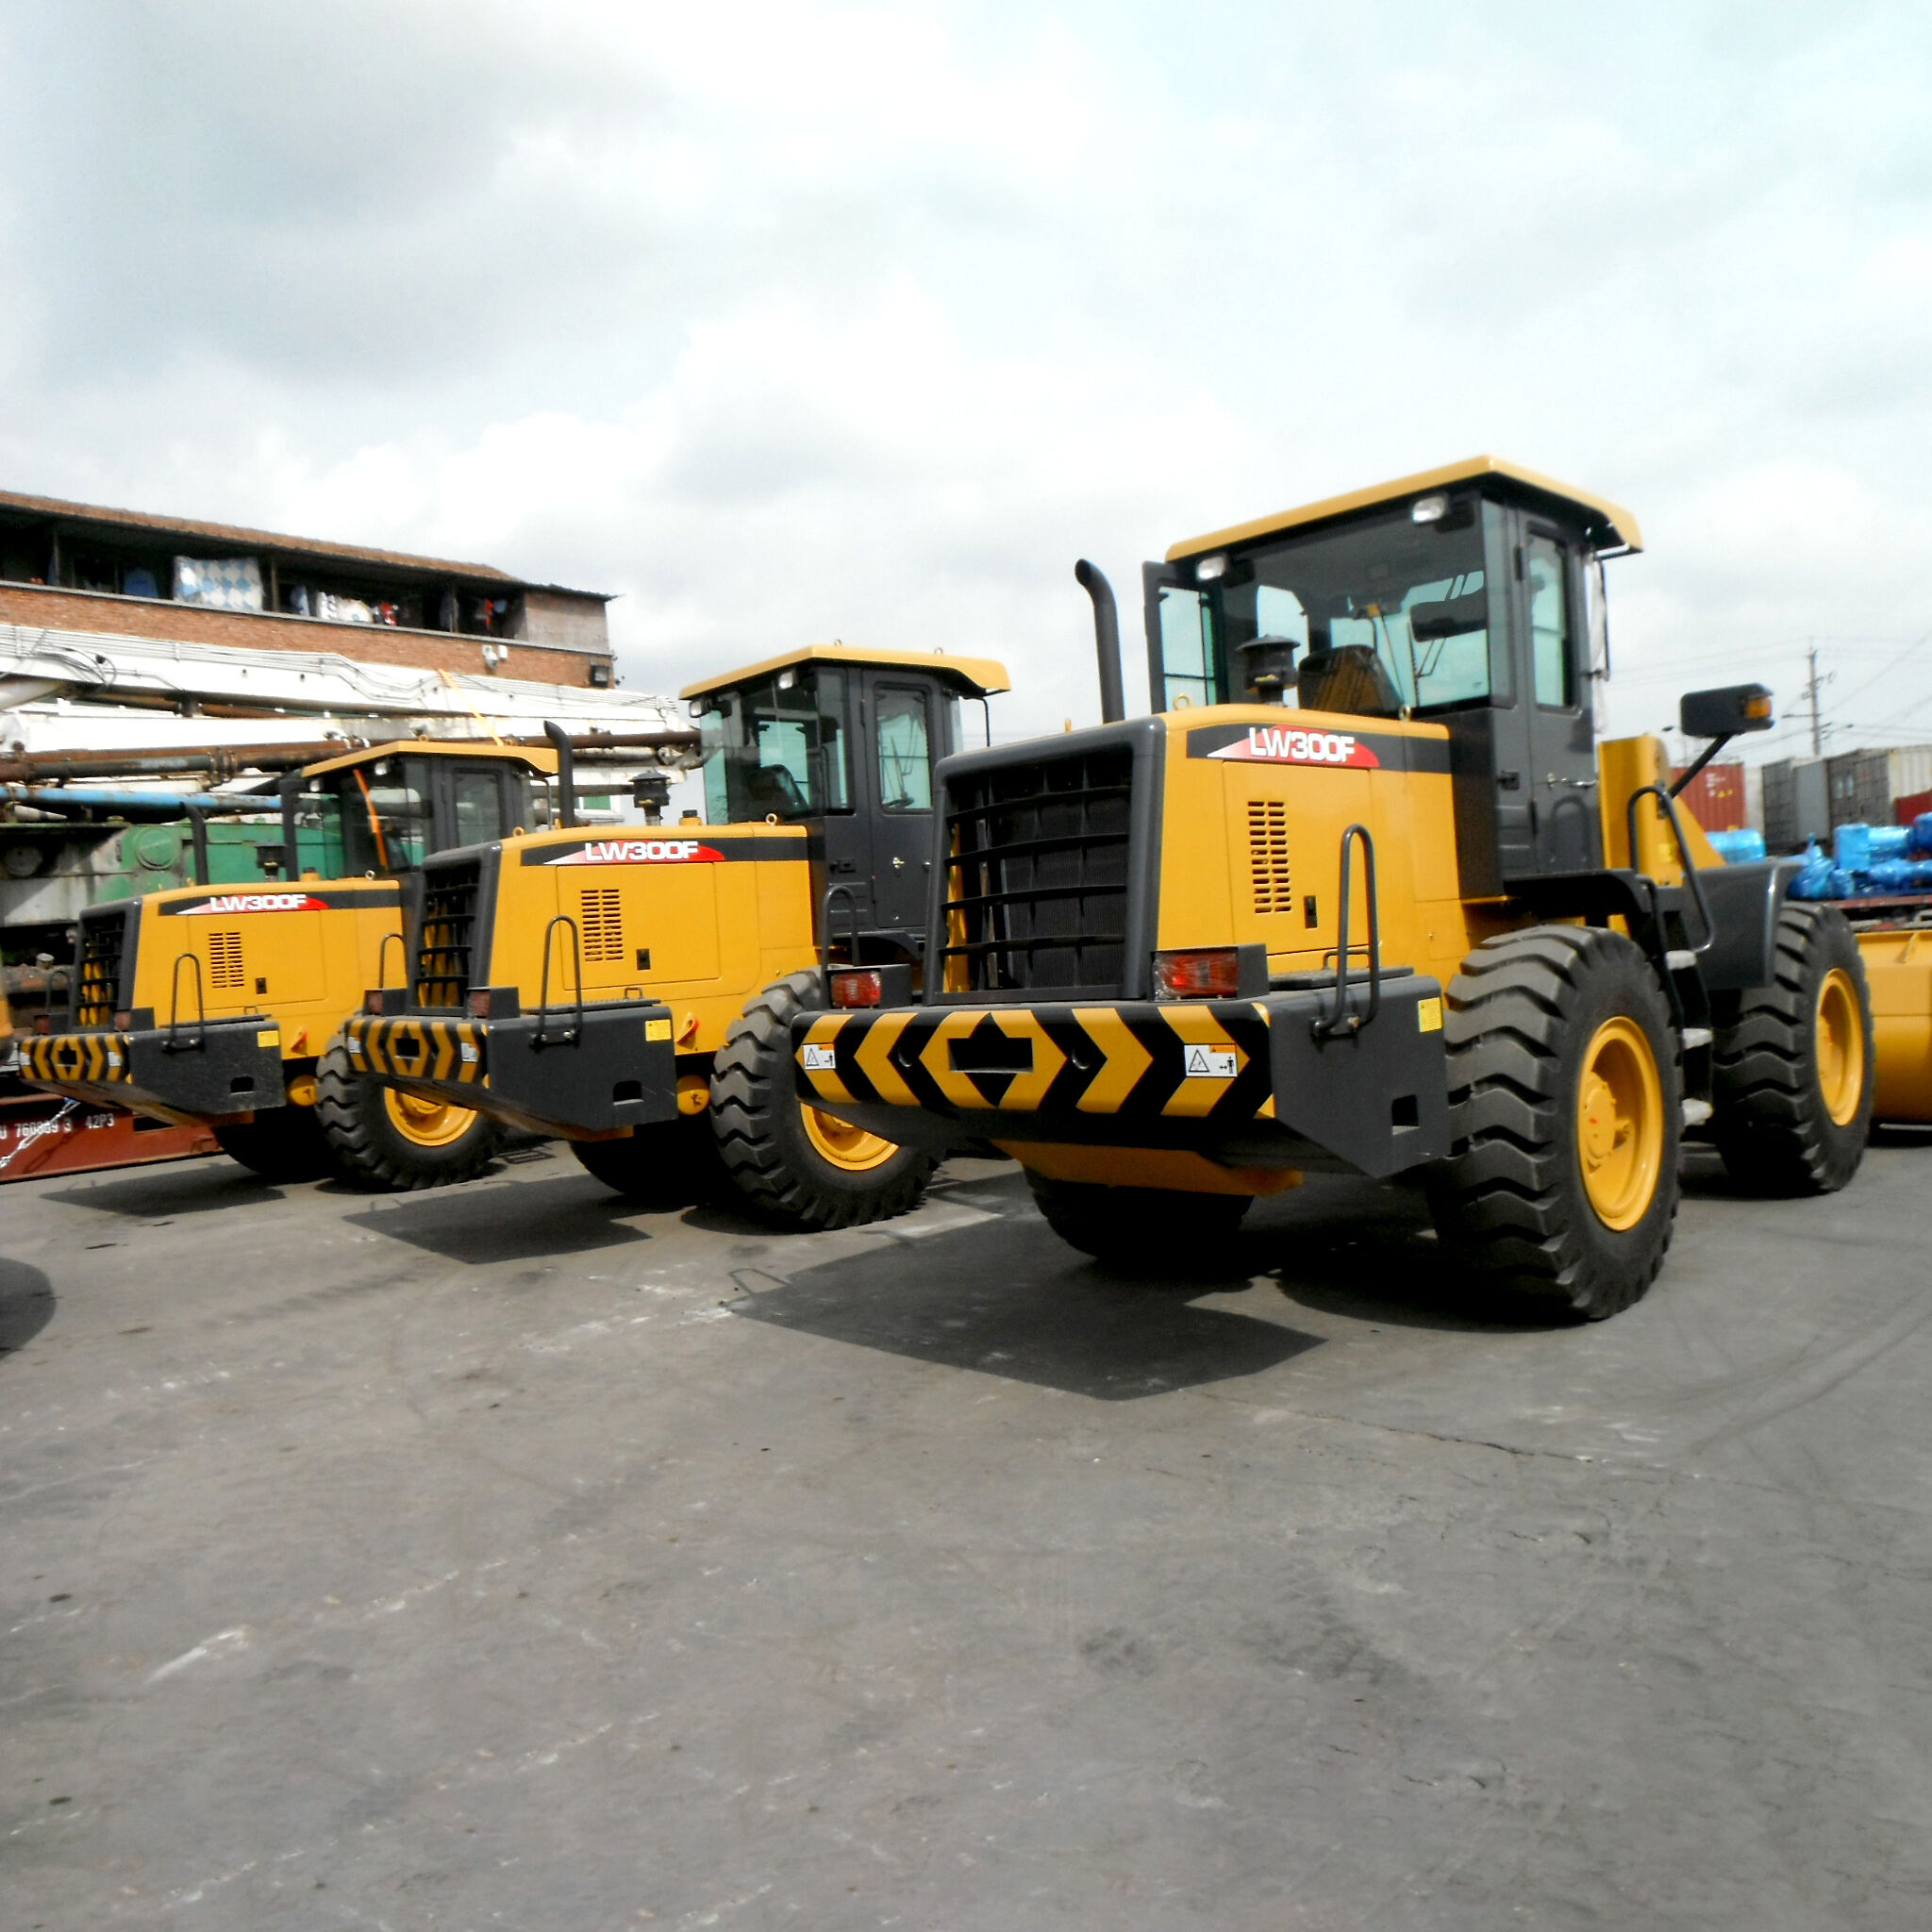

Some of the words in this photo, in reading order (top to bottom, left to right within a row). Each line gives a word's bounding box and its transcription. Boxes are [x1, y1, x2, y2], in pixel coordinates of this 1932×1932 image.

[1249, 726, 1355, 763] LW300F
[585, 841, 699, 861] LW300F
[209, 893, 308, 912] LW300F
[85, 1112, 115, 1129] 42P3
